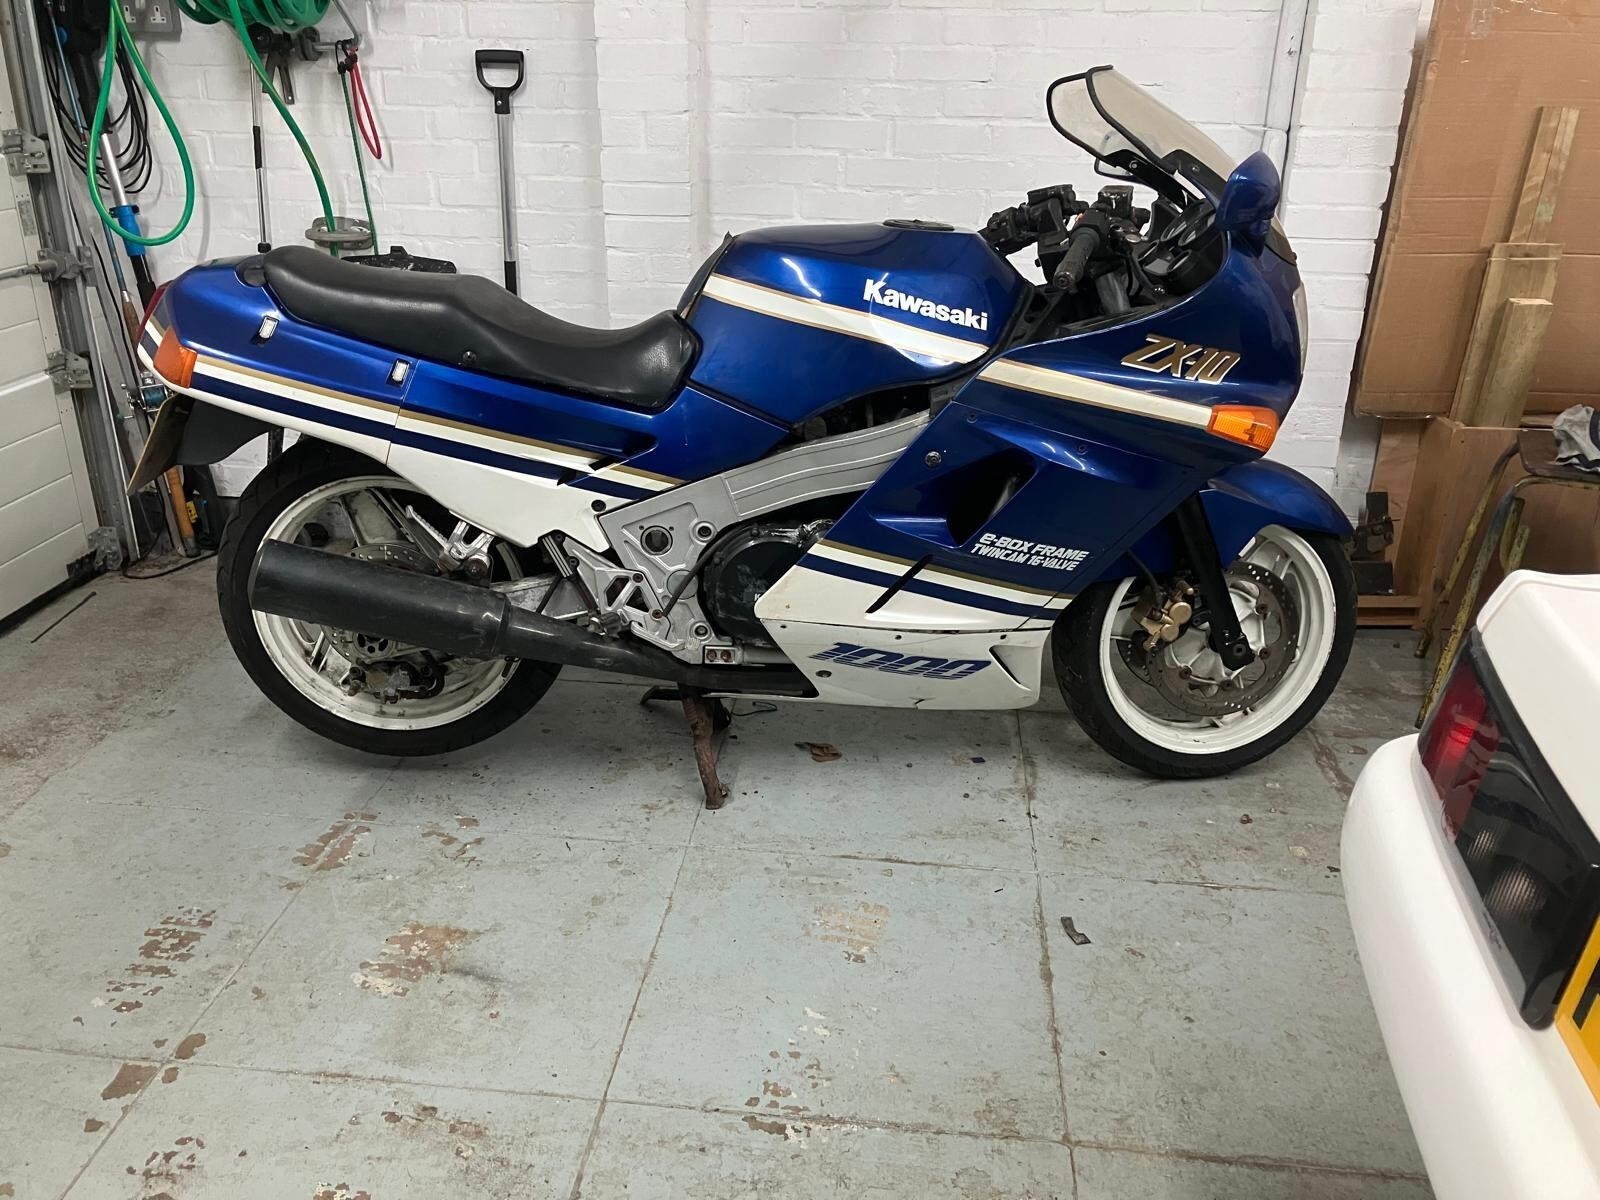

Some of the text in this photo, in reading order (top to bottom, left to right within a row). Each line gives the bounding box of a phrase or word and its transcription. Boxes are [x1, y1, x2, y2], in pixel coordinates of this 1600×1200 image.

[863, 278, 988, 331] Kawasaki
[1120, 333, 1241, 385] ZX-10
[970, 543, 1080, 571] TWINCAM 16-VALVE
[1030, 543, 1090, 561] FRAME
[807, 641, 992, 681] 1000
